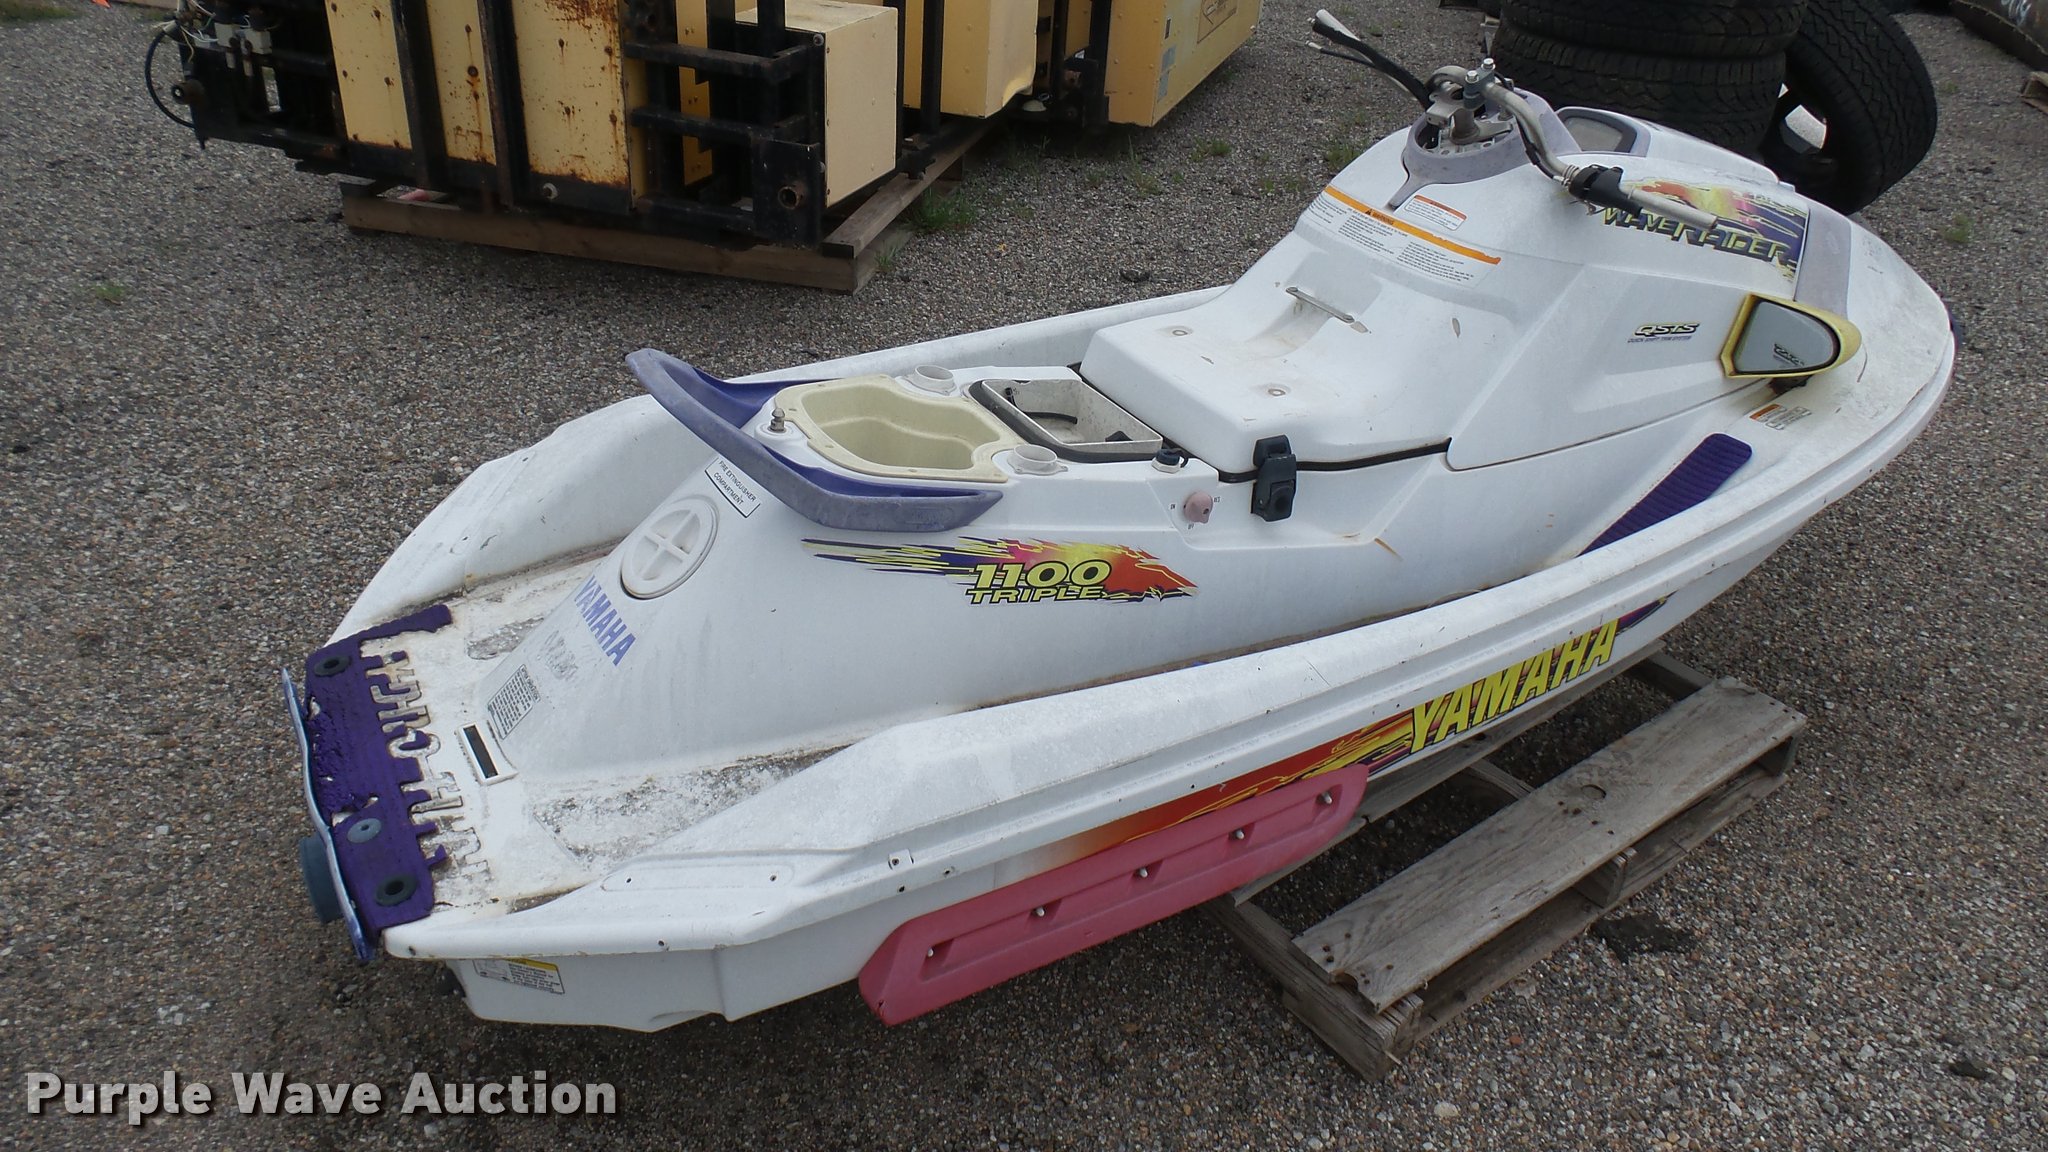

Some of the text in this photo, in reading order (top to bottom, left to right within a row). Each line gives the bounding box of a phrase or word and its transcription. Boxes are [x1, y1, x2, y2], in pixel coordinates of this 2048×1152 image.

[1634, 323, 1700, 338] QSTS
[713, 472, 744, 505] COMPARTMENT
[719, 460, 757, 502] FIRE EXTINGUISHER
[973, 559, 1112, 589] 1100
[966, 585, 1105, 605] TRIPLE
[574, 575, 637, 667] YAMAHA
[1410, 618, 1620, 754] YAMAHA
